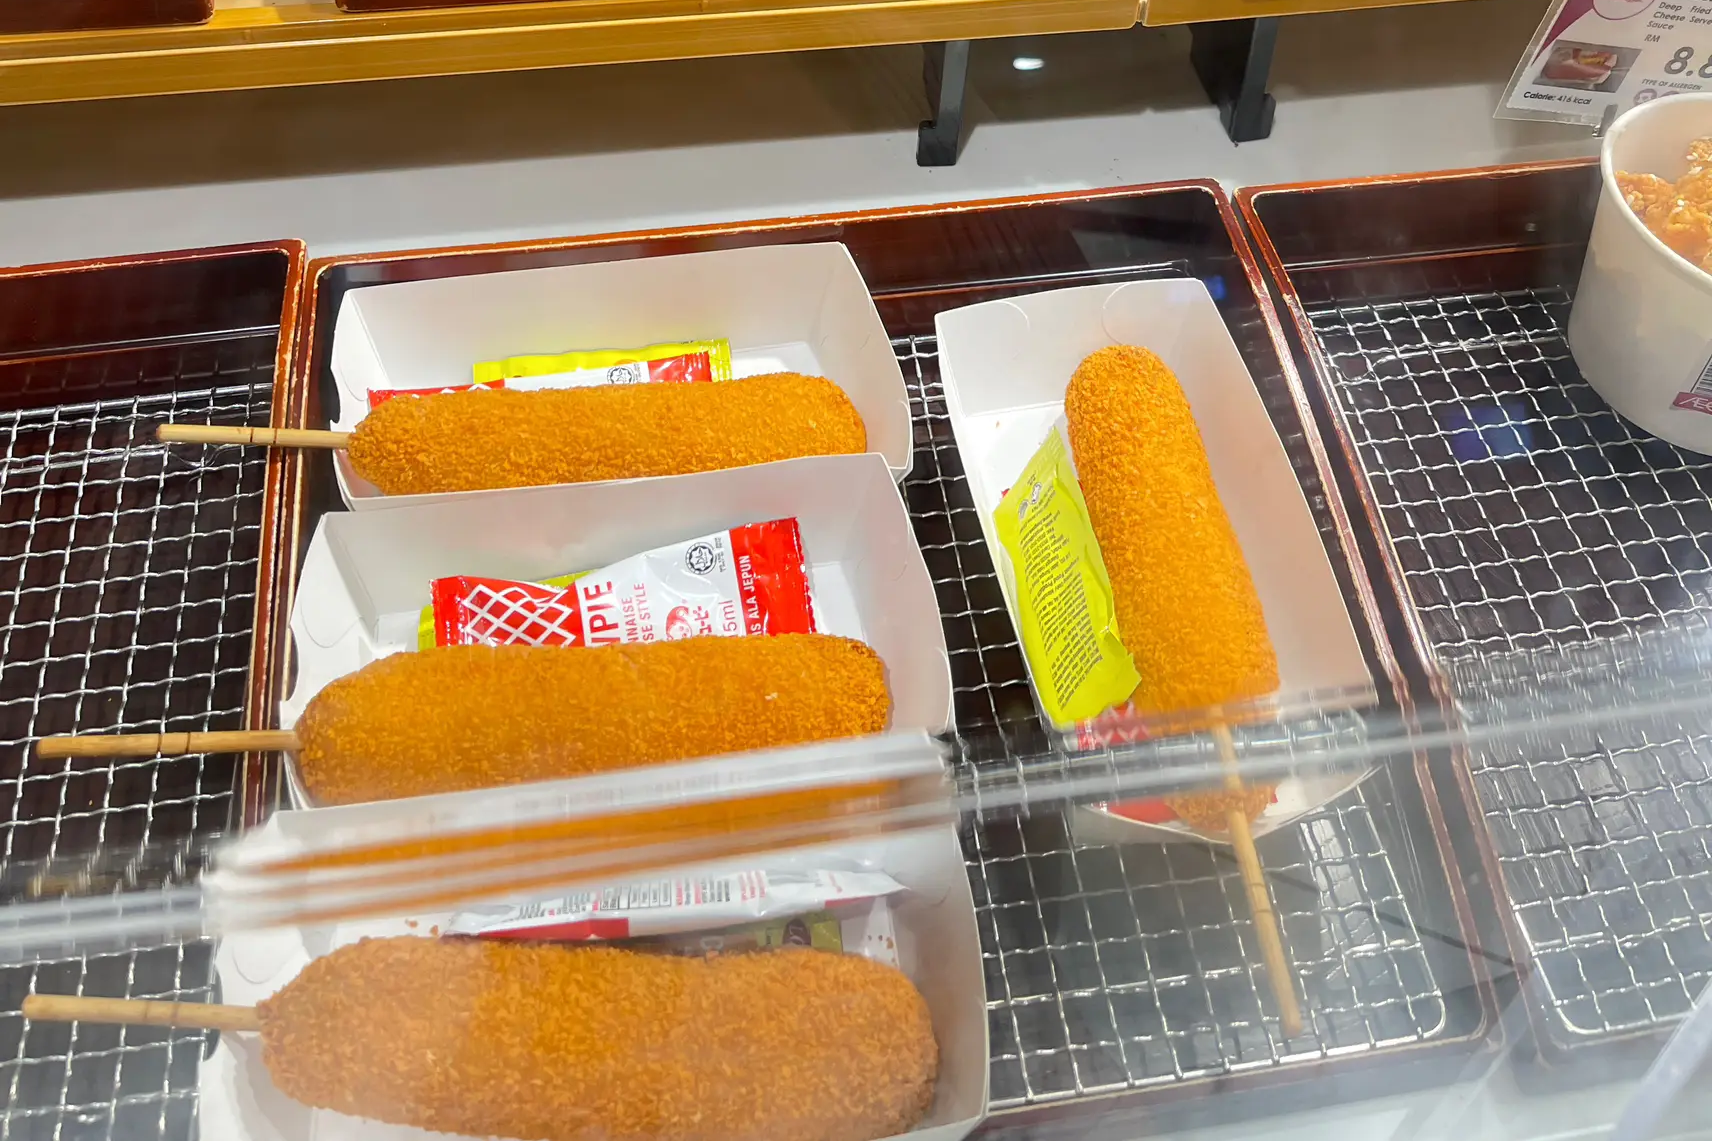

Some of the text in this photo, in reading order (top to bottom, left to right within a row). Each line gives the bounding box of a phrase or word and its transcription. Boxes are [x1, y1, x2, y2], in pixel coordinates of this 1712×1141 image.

[1658, 1, 1683, 12] Deep
[1653, 11, 1686, 22] Cheese
[1646, 20, 1674, 30] Sauce
[1644, 33, 1661, 43] RM
[1641, 78, 1657, 86] TYPE
[1523, 91, 1592, 105] Calorie: 416 kcal
[739, 555, 756, 593] JEPUN
[633, 583, 652, 620] STYLE
[745, 596, 760, 619] ALA
